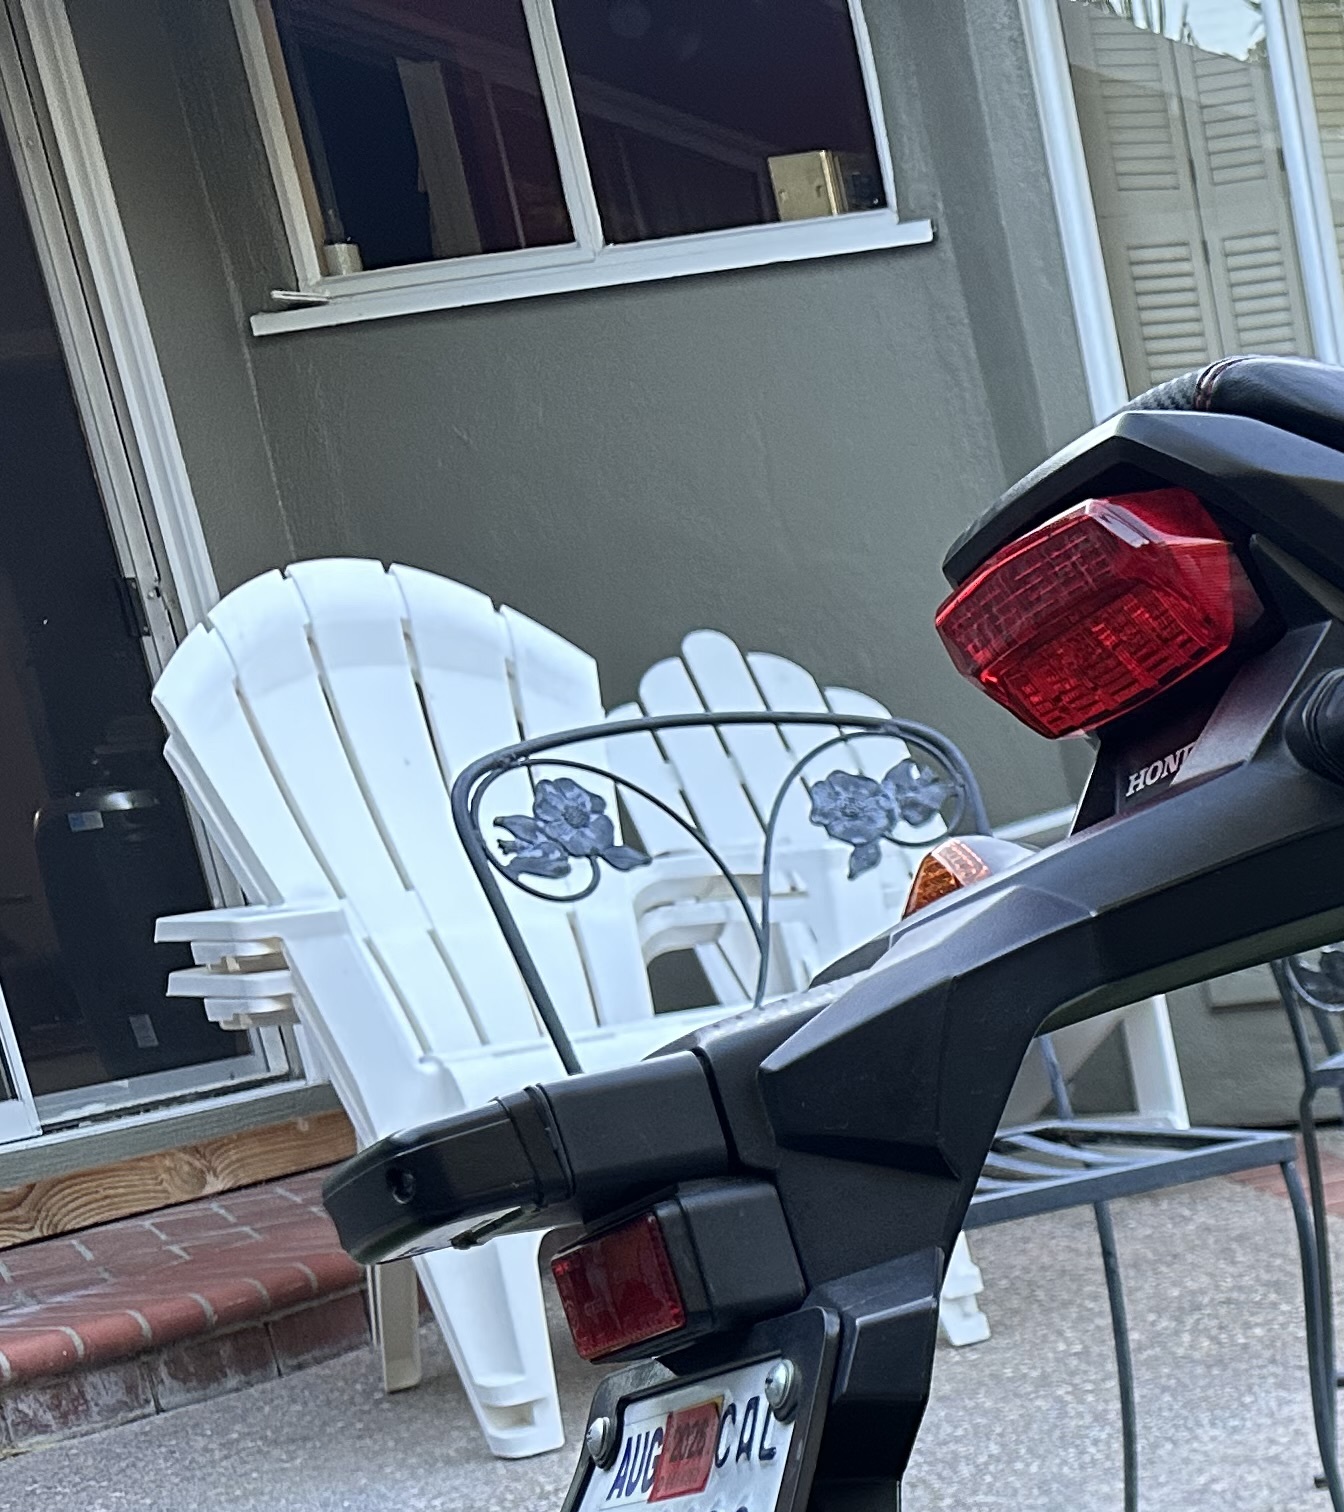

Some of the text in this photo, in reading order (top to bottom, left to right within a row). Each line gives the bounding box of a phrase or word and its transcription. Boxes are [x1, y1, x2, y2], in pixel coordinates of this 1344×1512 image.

[1126, 742, 1197, 797] HON
[606, 1395, 777, 1500] AUG CAL
